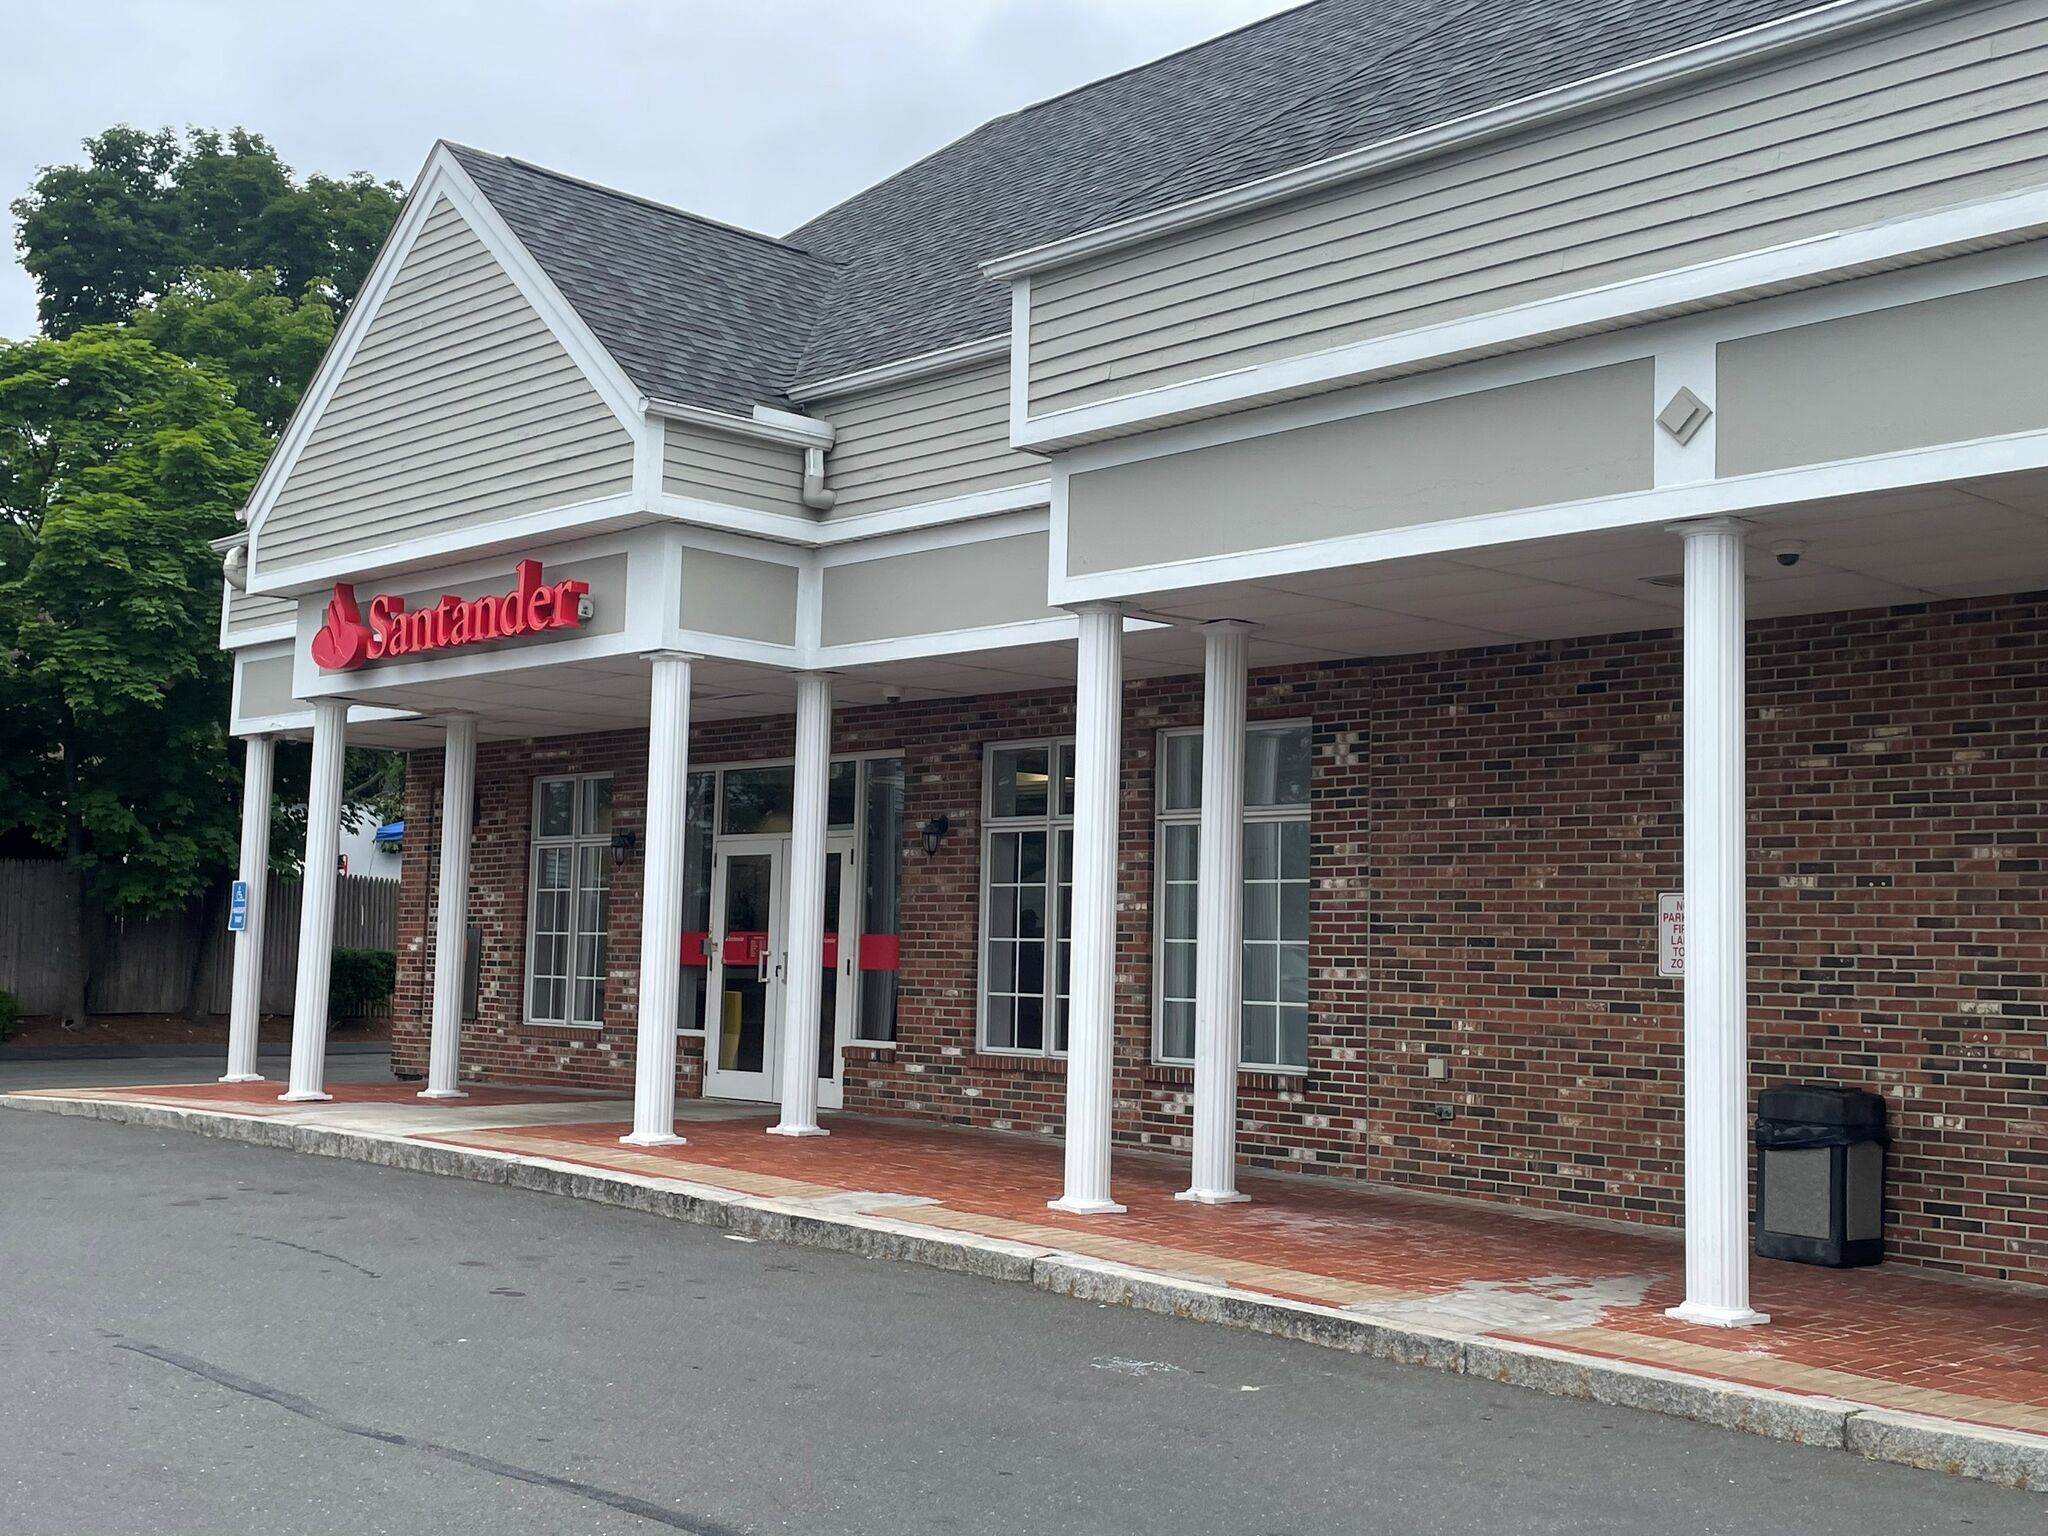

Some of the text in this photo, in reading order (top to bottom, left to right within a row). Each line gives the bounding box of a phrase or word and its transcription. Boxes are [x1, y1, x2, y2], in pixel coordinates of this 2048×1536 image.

[367, 560, 588, 659] Santander
[1671, 936, 1684, 945] LA
[1673, 947, 1684, 957] TO
[1671, 959, 1684, 968] ZO
